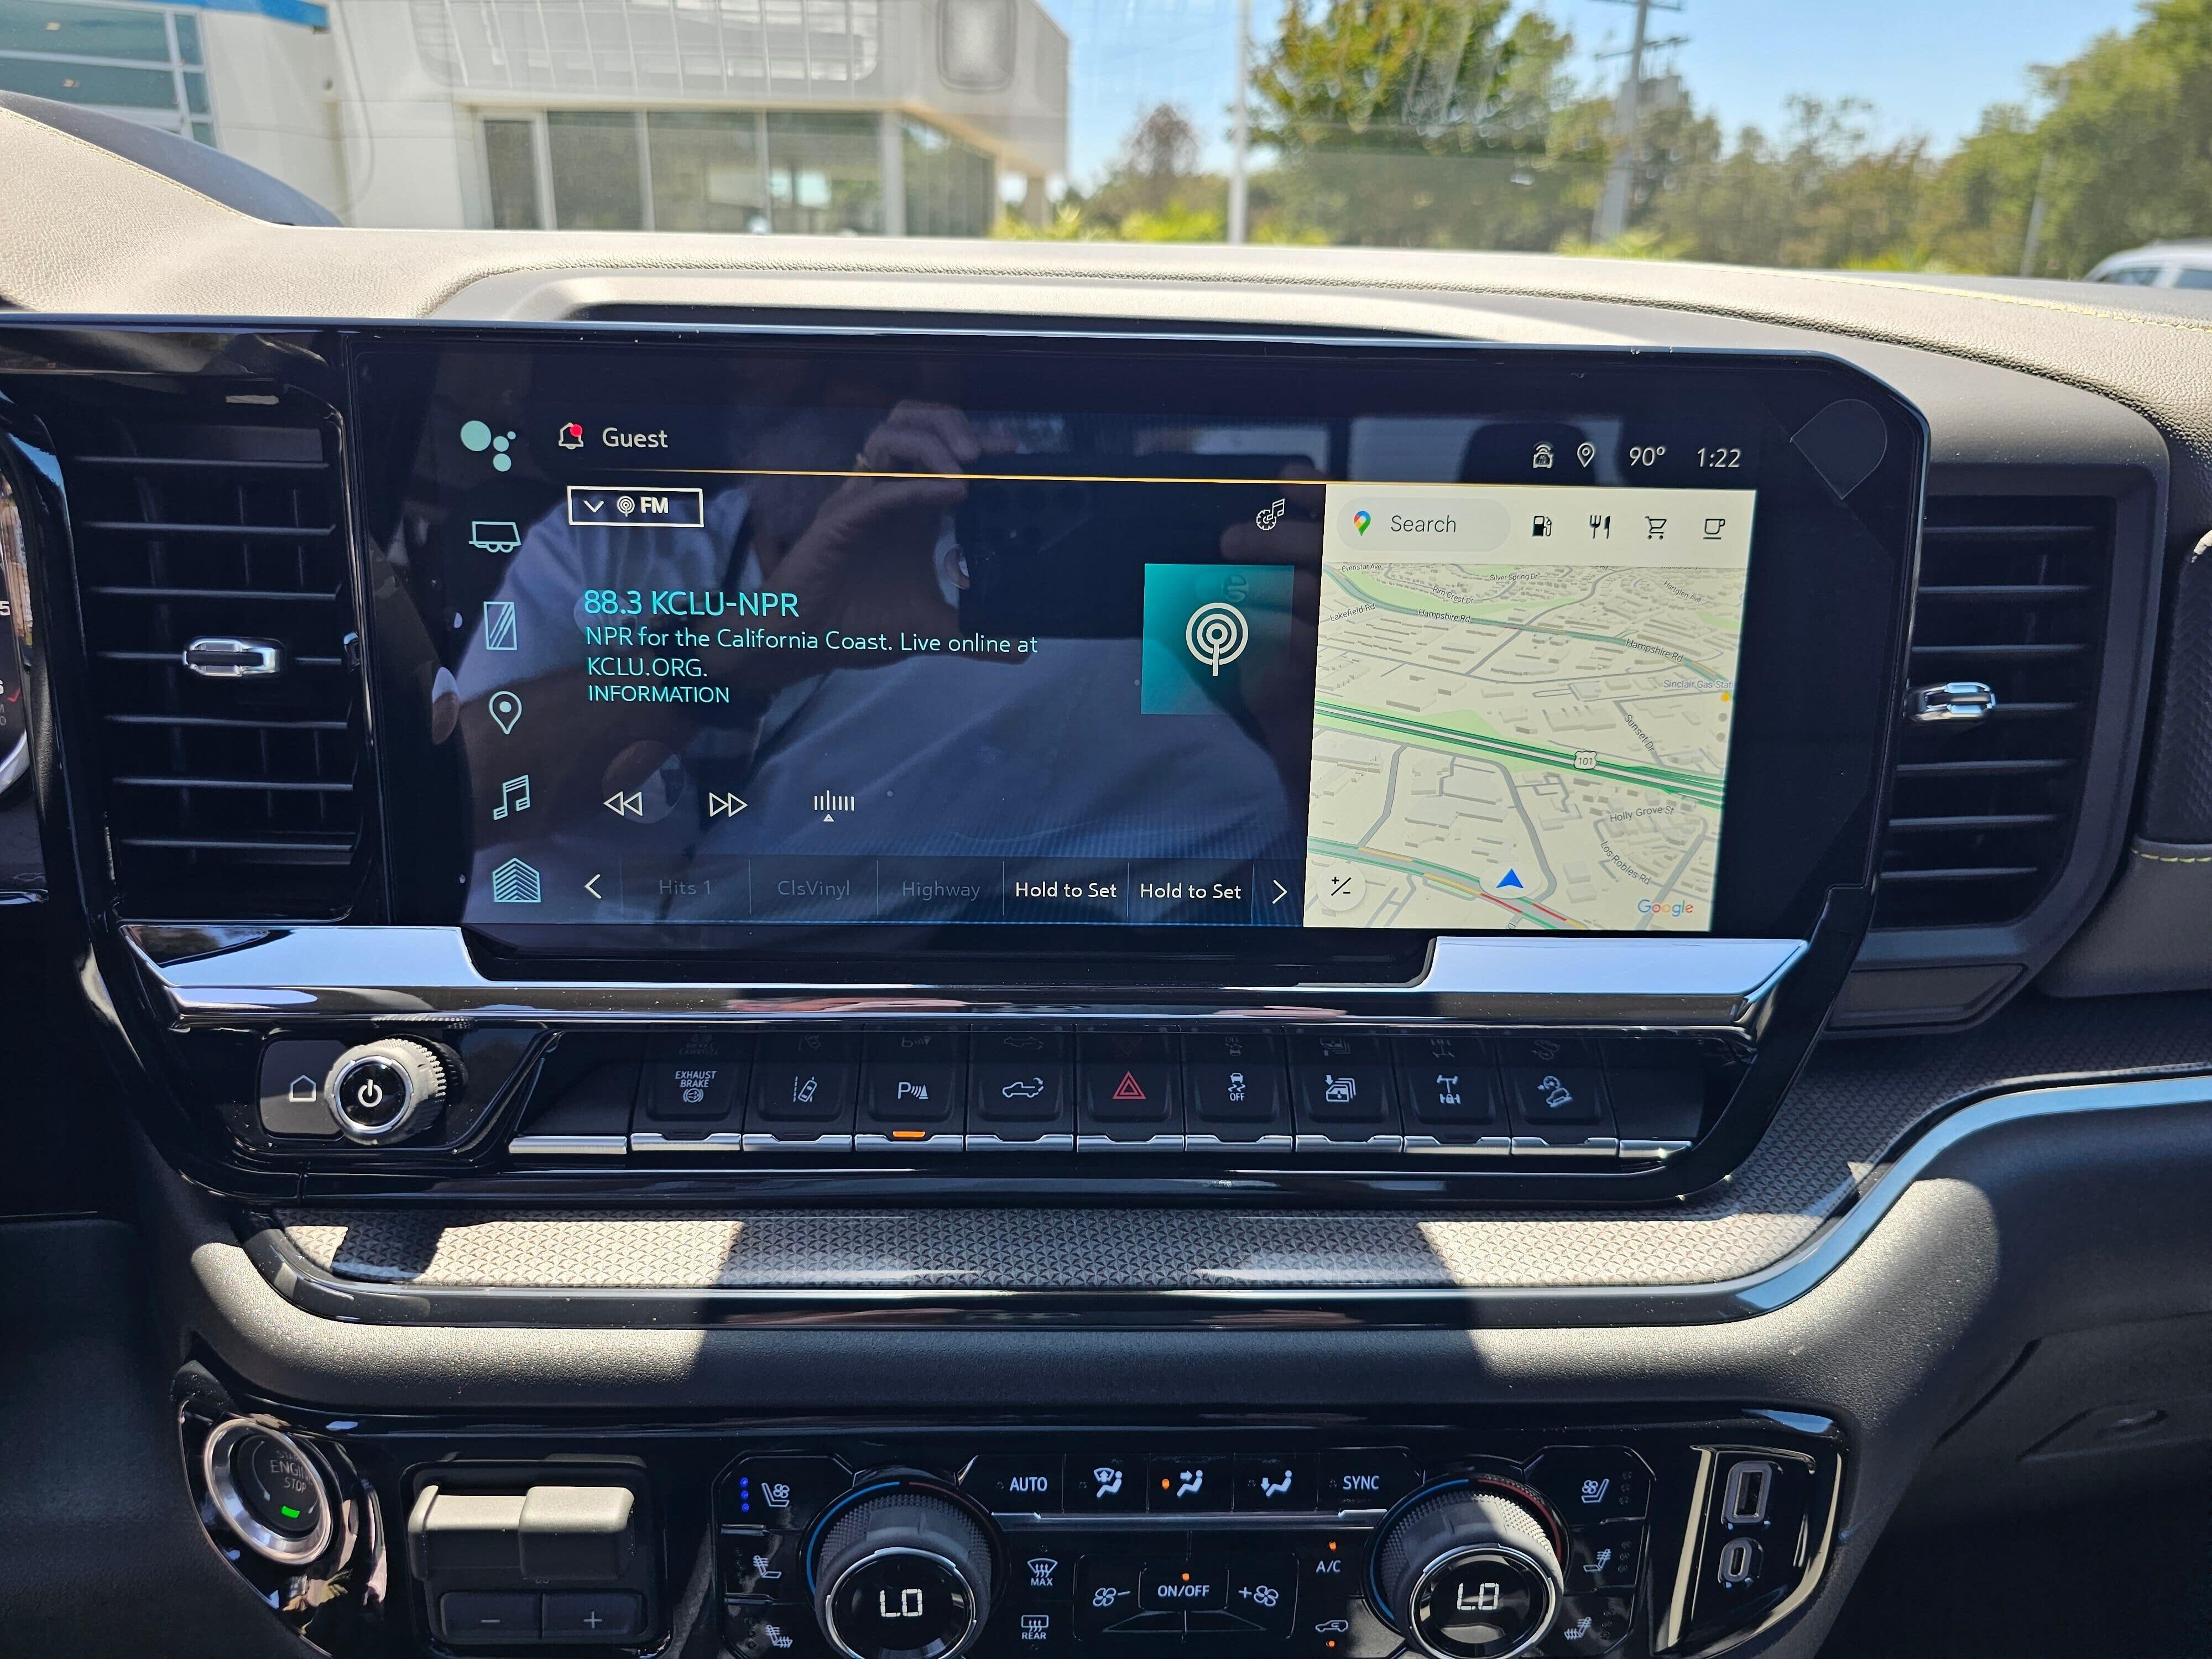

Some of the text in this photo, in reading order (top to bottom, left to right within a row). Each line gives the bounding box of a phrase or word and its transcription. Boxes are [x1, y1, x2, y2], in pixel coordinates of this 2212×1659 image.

[603, 428, 668, 448] Guest
[1697, 447, 1741, 468] 1:22
[641, 498, 668, 513] FM
[1391, 515, 1456, 533] Search
[1432, 586, 1446, 596] Rim
[1446, 592, 1464, 603] Crest
[1663, 581, 1688, 598] Hartglen
[584, 589, 800, 617] 88.3 KCLU-NPR
[1331, 603, 1375, 622] Lakefield Rd
[1418, 609, 1459, 621] Hampshire
[586, 627, 1038, 653] NPR for the California Coast. Live online at
[1626, 639, 1683, 662] Hampshire Rd
[588, 657, 707, 677] KCLU.ORG.
[1663, 680, 1694, 688] Sinclair
[588, 685, 729, 703] INFORMATION
[1624, 714, 1655, 752] Sunset Dr
[1610, 806, 1674, 822] Holly Grove St
[1600, 841, 1651, 885] Los Robles Rd
[659, 880, 711, 895] Hits 1
[778, 880, 850, 900] ClsVinyl
[902, 880, 980, 901] Highway
[1015, 881, 1117, 898] Hold to Set
[1140, 883, 1241, 900] Hold to Set
[1637, 899, 1694, 916] Google
[675, 1071, 717, 1079] EXHAUST
[680, 1079, 709, 1088] BRAKE
[898, 1082, 911, 1099] P
[1229, 1092, 1245, 1102] OFF
[284, 1477, 306, 1493] STOP
[1010, 1477, 1048, 1491] AUTO
[1343, 1475, 1380, 1491] SYNC
[1316, 1559, 1341, 1574] A/C
[1030, 1577, 1053, 1587] MAX
[1157, 1584, 1210, 1598] ON/OFF
[1021, 1631, 1046, 1640] REAR
